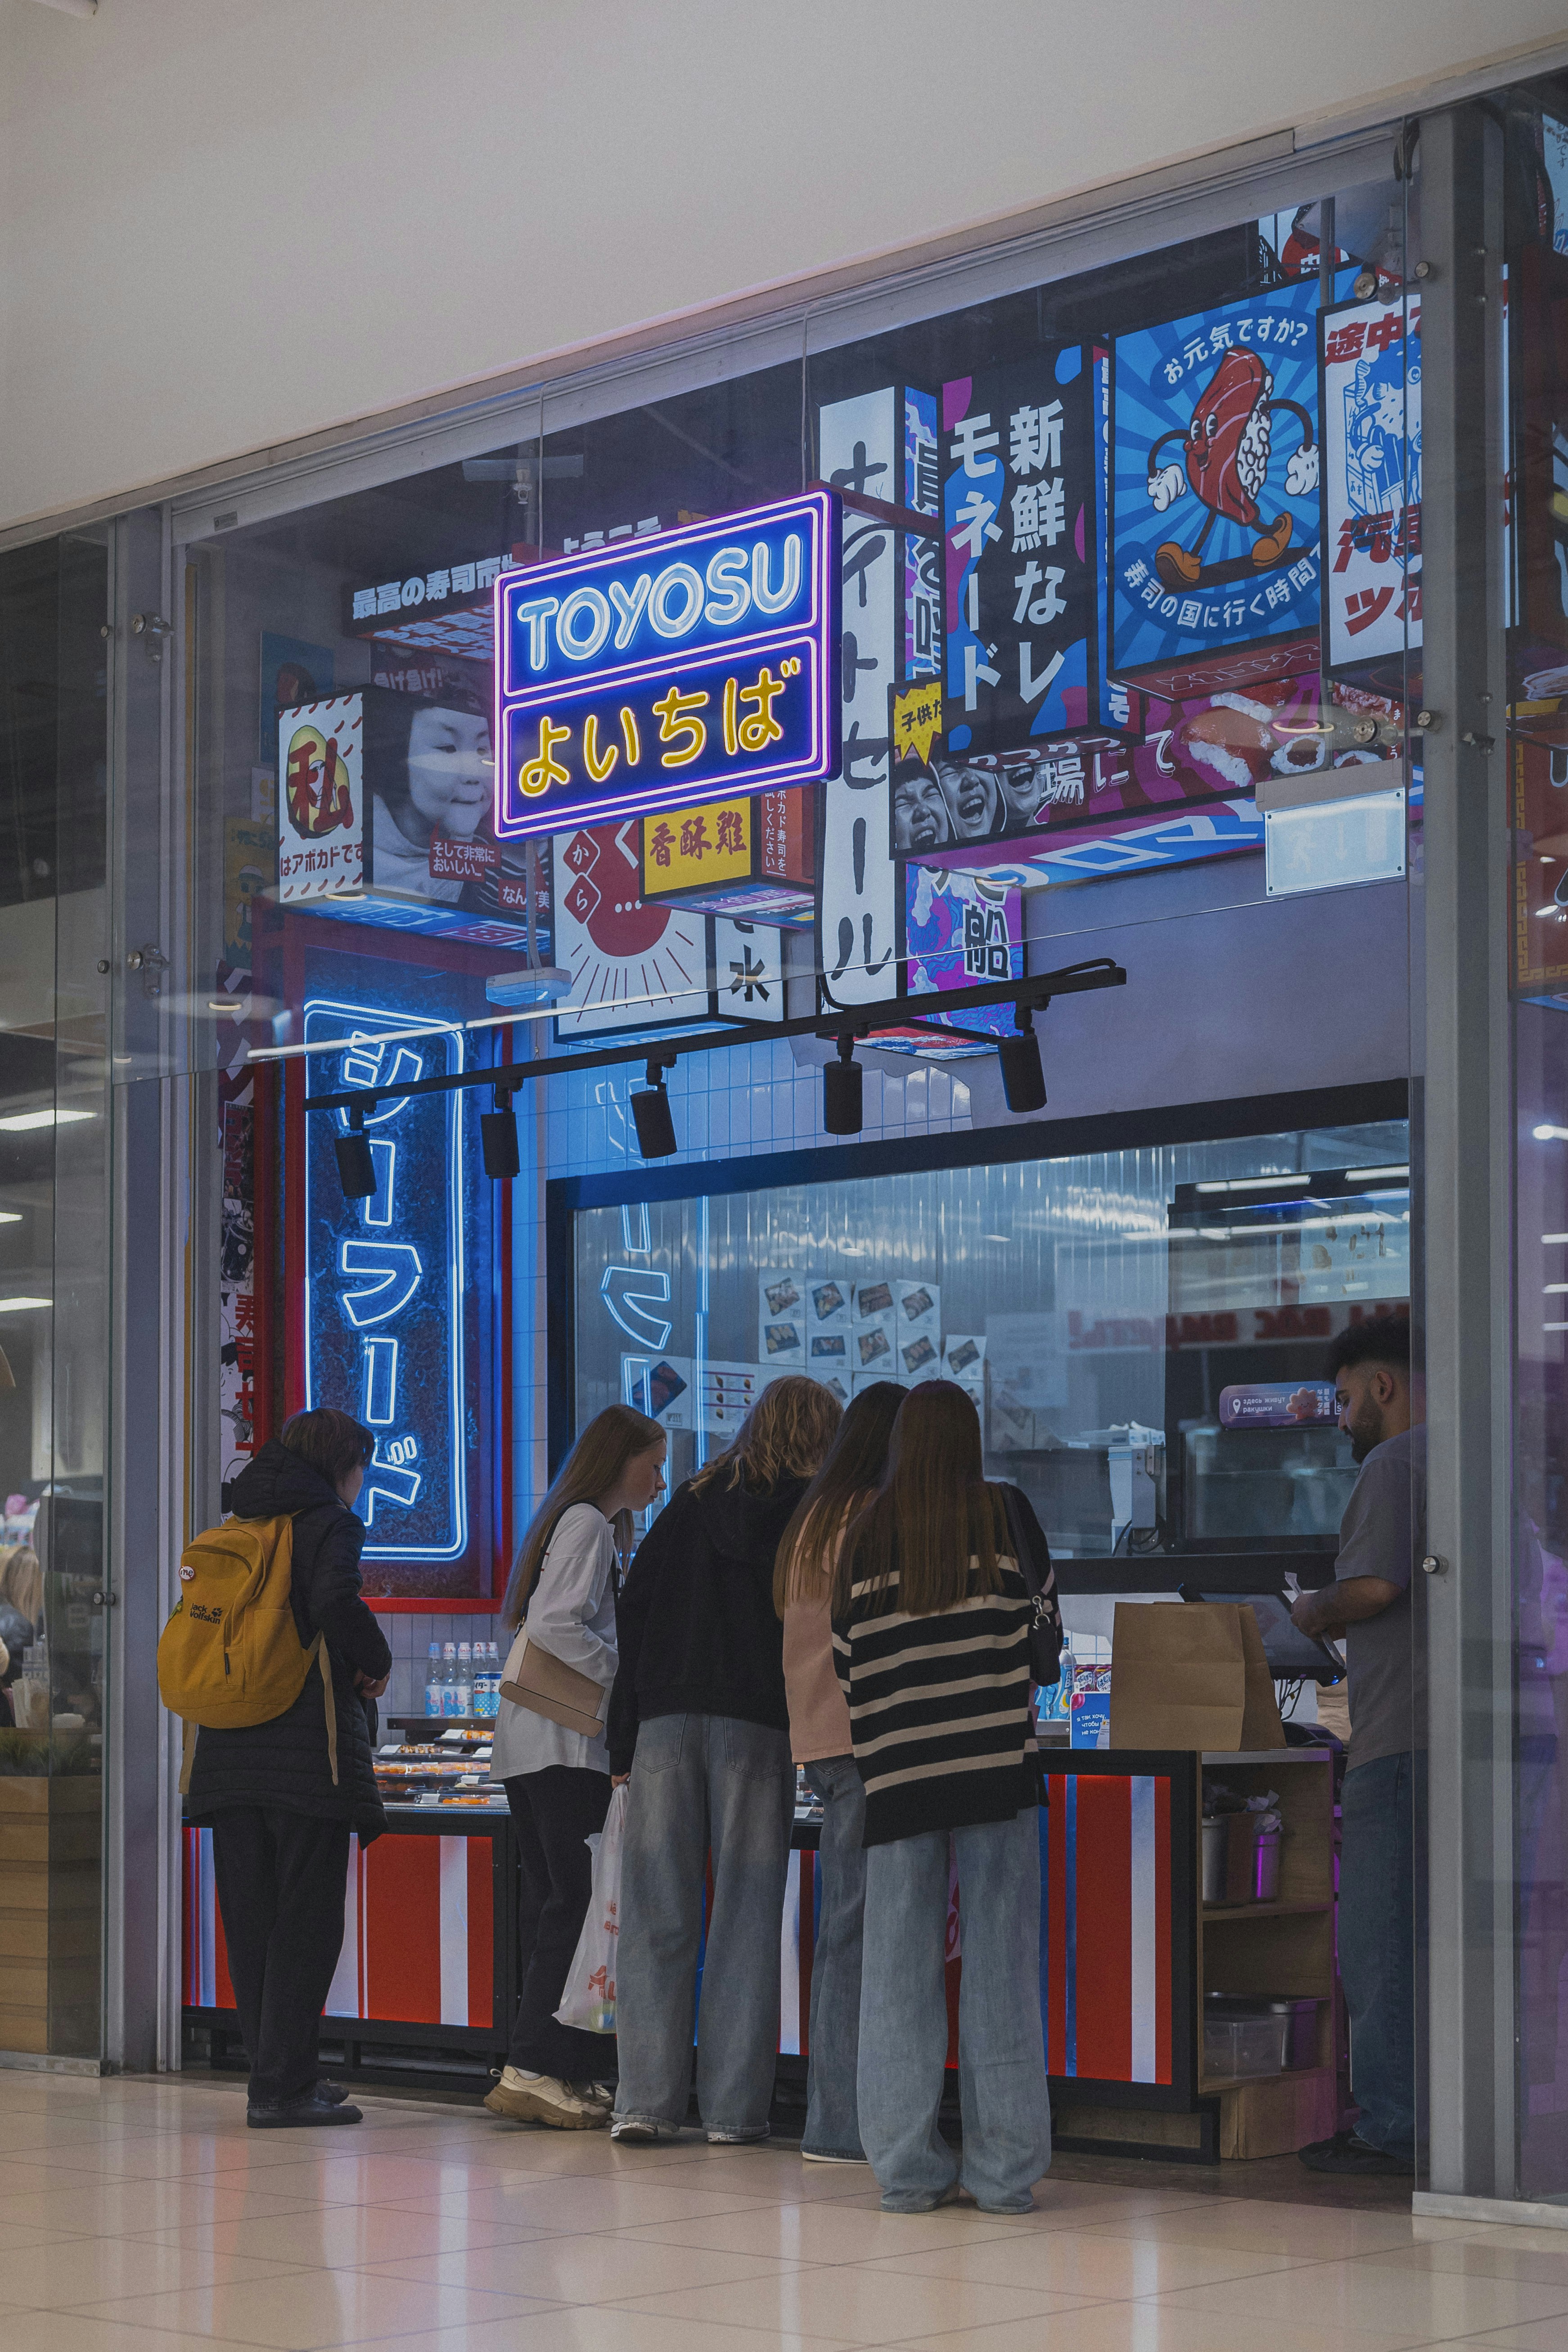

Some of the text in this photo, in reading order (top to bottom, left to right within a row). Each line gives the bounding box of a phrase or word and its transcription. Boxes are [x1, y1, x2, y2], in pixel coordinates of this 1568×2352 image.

[1165, 317, 1308, 384] お元気ですか?
[1326, 302, 1421, 367] 途中
[517, 533, 804, 671] TOYOSU
[950, 413, 1005, 712] モネード
[1008, 398, 1067, 704] 新鮮なレ
[519, 657, 802, 798] よいちば
[288, 737, 354, 840] 私
[433, 842, 495, 863] そして非常に
